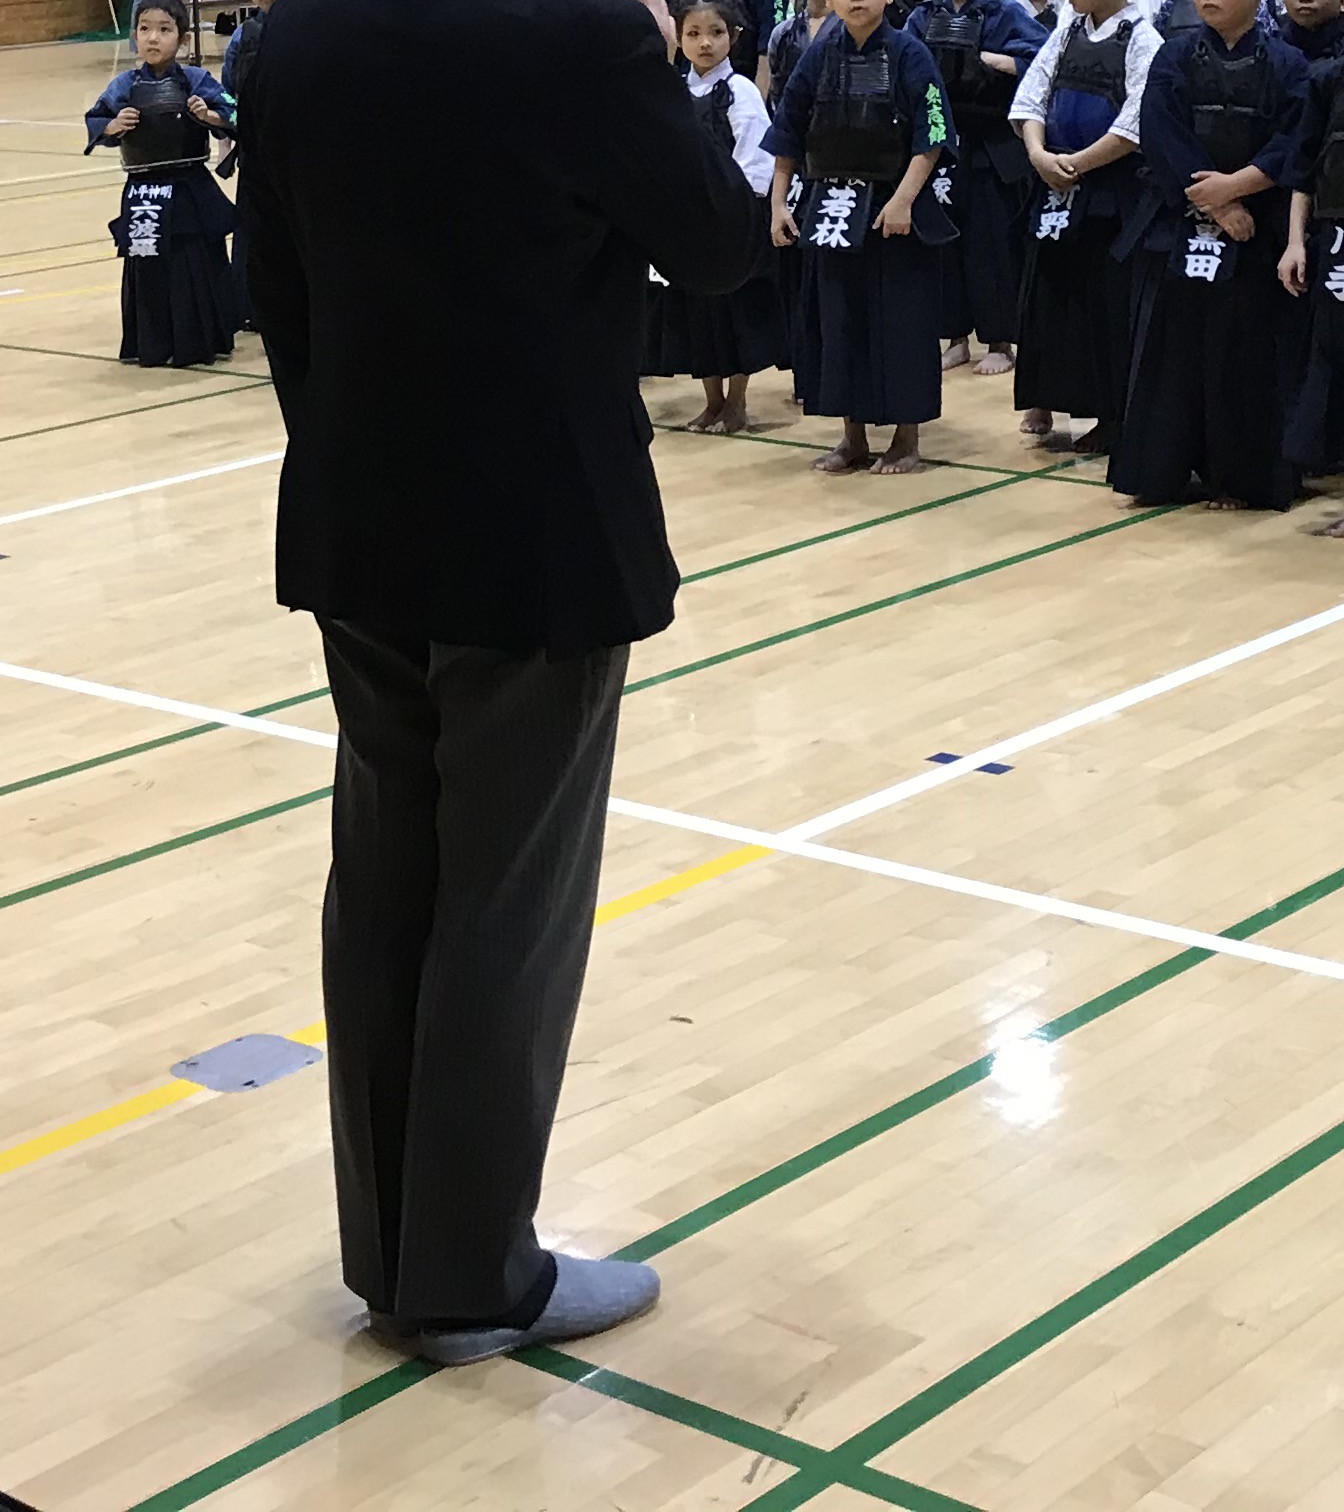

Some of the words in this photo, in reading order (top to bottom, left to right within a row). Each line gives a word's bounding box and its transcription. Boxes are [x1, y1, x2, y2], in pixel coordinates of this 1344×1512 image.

[128, 185, 173, 199] 小平神明
[809, 185, 857, 249] 若林
[128, 200, 163, 257] 六波羅
